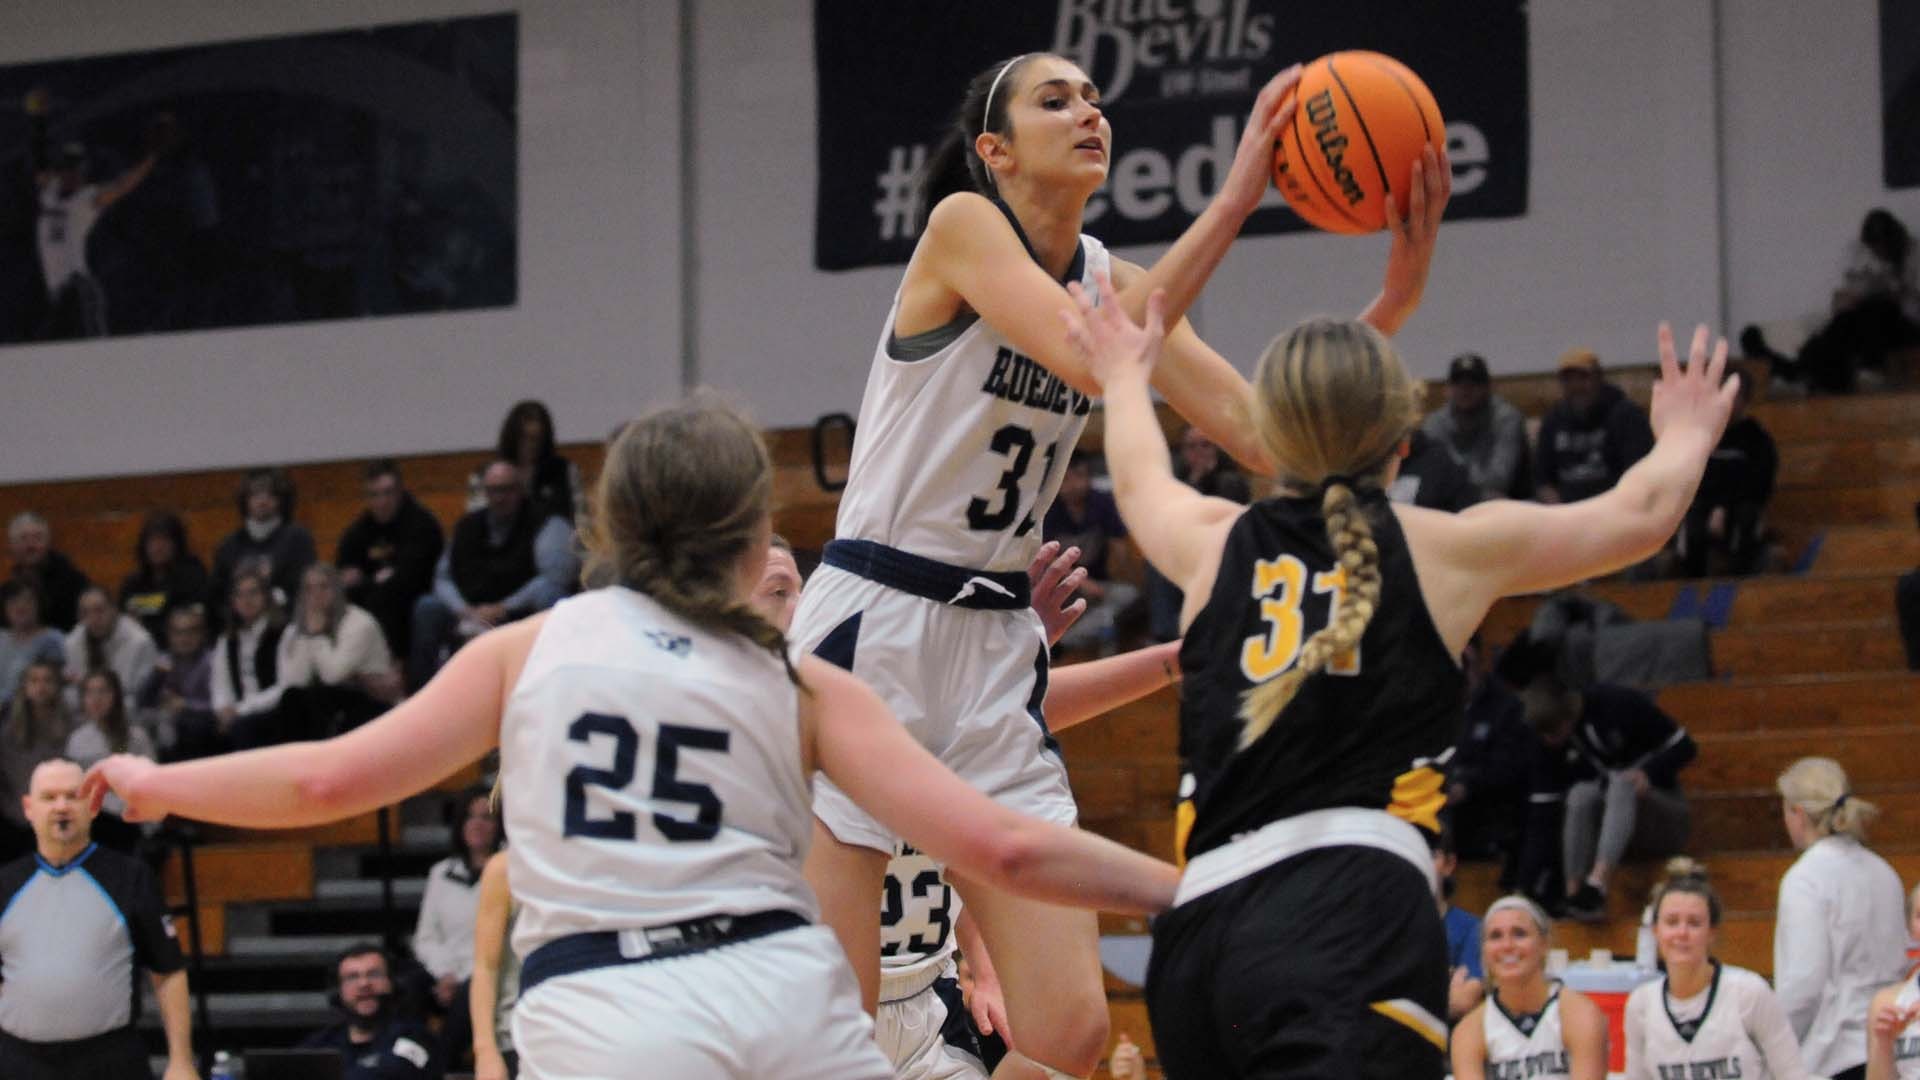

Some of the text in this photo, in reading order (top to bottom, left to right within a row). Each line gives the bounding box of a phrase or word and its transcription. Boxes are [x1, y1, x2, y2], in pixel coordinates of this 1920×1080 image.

[1080, 0, 1276, 106] Devils
[1306, 89, 1364, 206] Wilson
[1241, 554, 1362, 683] 31
[563, 712, 730, 841] 25
